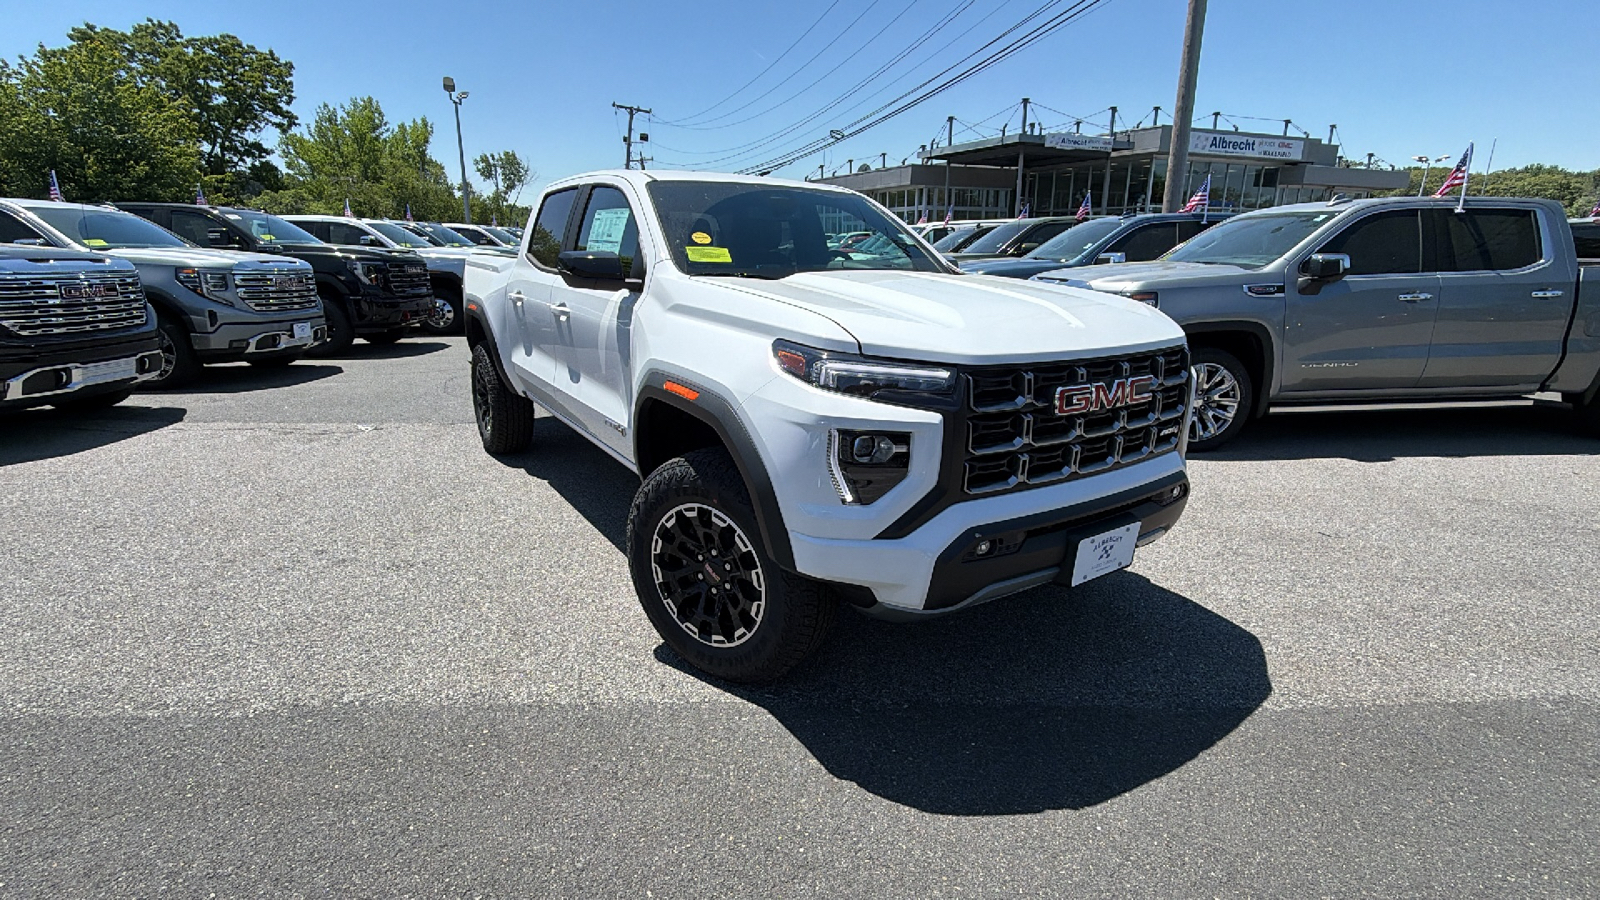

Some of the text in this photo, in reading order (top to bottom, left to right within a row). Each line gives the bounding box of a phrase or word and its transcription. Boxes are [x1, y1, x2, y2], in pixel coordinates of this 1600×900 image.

[1061, 137, 1087, 146] Albrecht
[1209, 136, 1256, 151] Albrecht
[61, 283, 118, 299] GMC
[1055, 375, 1154, 416] GMC
